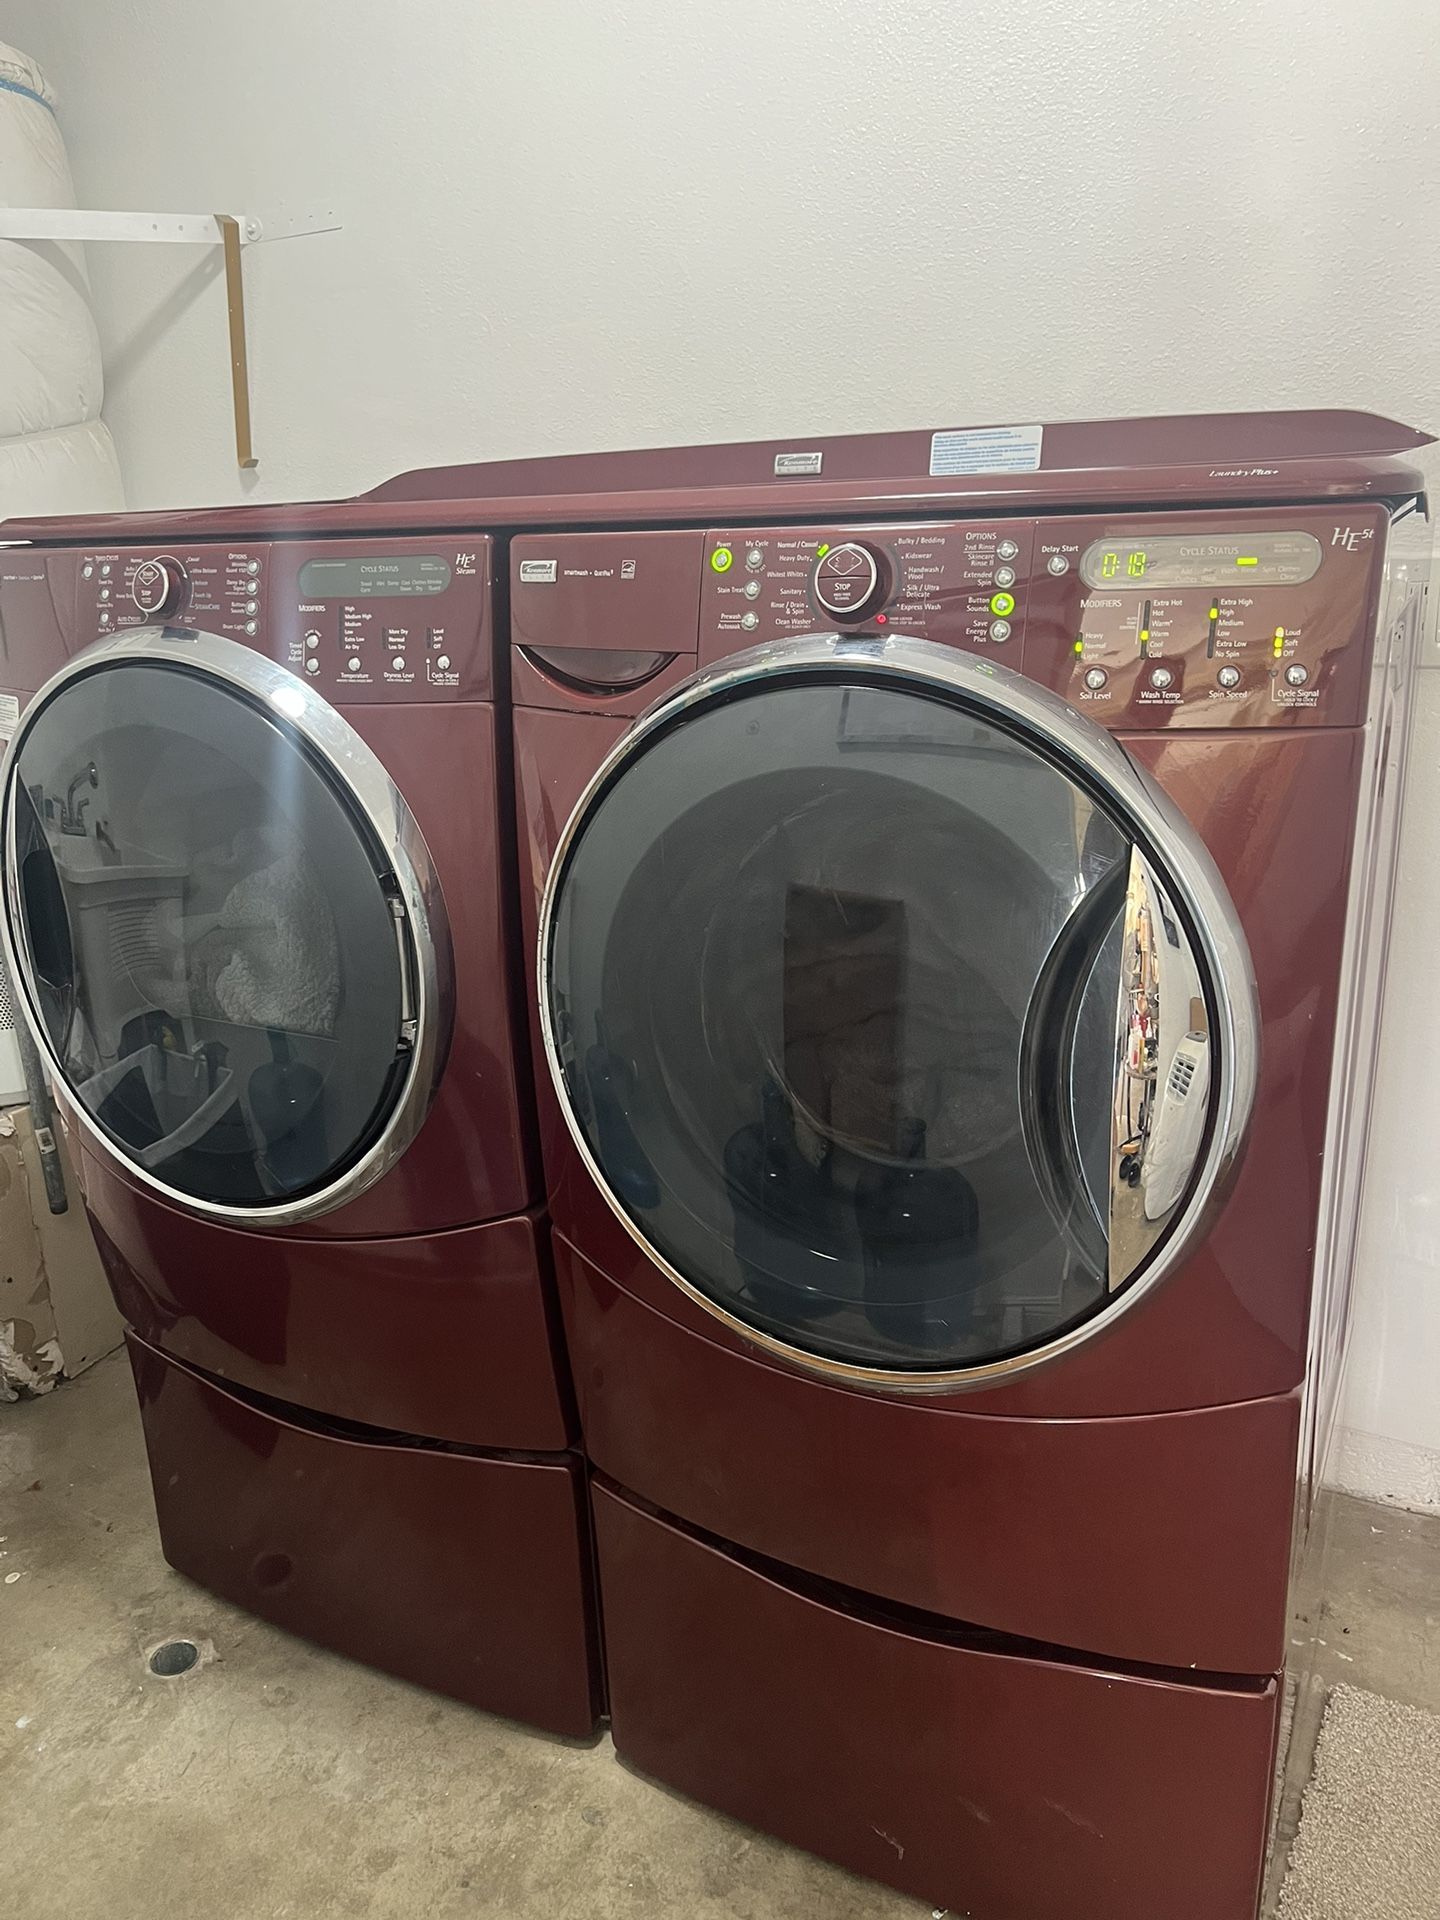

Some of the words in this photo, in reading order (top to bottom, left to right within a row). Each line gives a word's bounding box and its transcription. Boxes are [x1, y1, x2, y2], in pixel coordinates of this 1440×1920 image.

[965, 532, 997, 540] OPTIONS
[898, 537, 914, 545] Bulky
[920, 537, 945, 545] Bedding
[1041, 545, 1060, 554] Delay
[1061, 544, 1079, 552] Start
[1179, 546, 1206, 556] CYCLE
[1207, 545, 1240, 555] STATUS
[456, 567, 476, 575] Steam
[834, 582, 851, 591] STOP
[900, 603, 923, 611] Express
[1080, 599, 1122, 608] MODIFIERS
[1238, 599, 1254, 607] High
[298, 604, 326, 612] MODIFIERS
[1219, 609, 1235, 617] High
[965, 628, 988, 637] Energy
[1085, 632, 1104, 640] Heavy
[1083, 652, 1099, 660] Light
[1225, 650, 1240, 659] Spin
[1283, 649, 1295, 657] Off
[340, 672, 370, 680] Temperature
[1079, 692, 1093, 700] Soil
[1093, 692, 1112, 700] Level
[1140, 691, 1160, 699] Wash
[1161, 691, 1181, 700] Temp
[1208, 690, 1225, 699] Spin
[1226, 691, 1248, 699] Speed
[1277, 690, 1297, 698] Cycle
[1297, 689, 1320, 698] Signal
